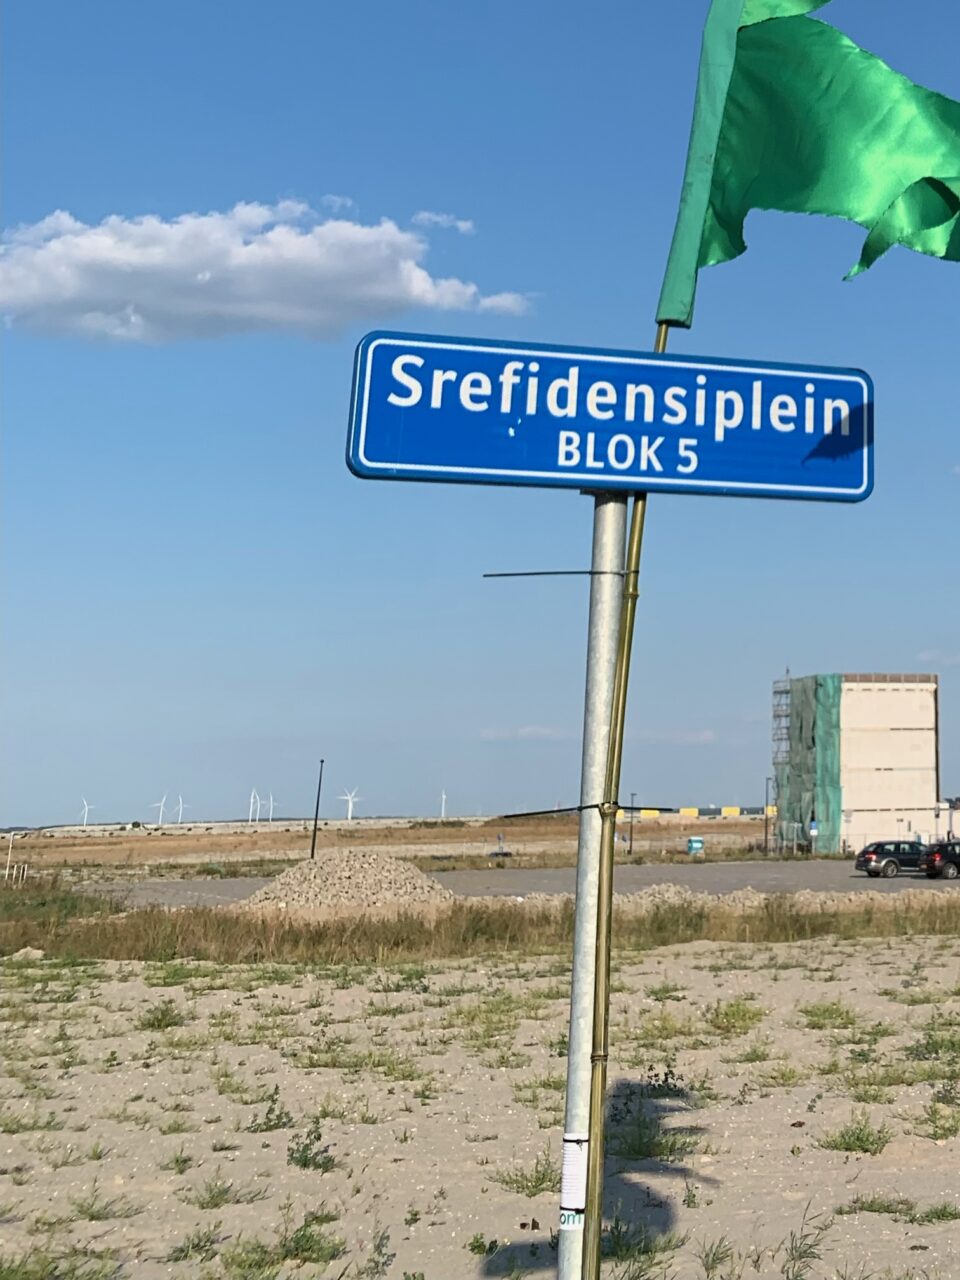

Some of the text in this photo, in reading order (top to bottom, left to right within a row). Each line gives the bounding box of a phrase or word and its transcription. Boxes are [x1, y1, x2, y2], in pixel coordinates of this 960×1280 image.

[387, 354, 851, 442] Srefidensiplein
[557, 430, 699, 474] BLOK 5
